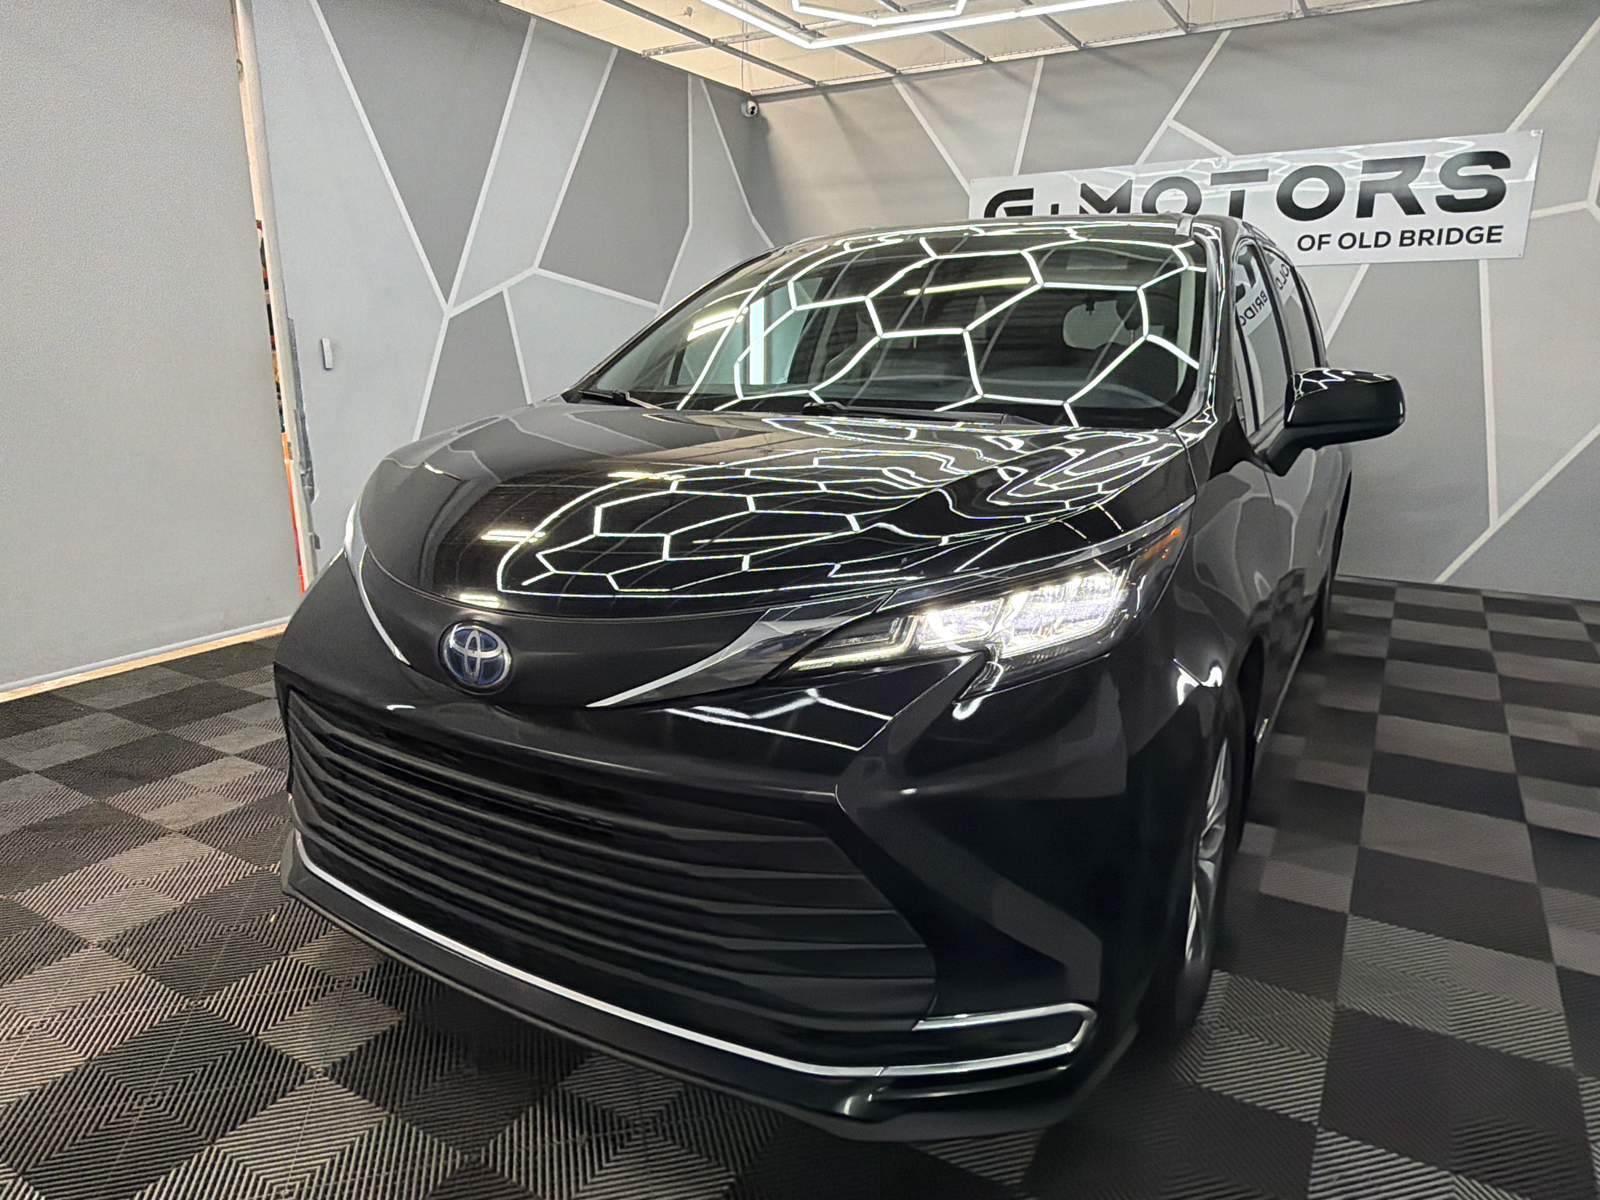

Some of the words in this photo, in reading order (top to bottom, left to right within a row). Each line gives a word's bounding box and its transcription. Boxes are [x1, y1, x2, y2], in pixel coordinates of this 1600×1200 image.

[1297, 233, 1332, 251] OF
[1338, 231, 1391, 250] OLD
[1399, 225, 1504, 247] BRIDGE
